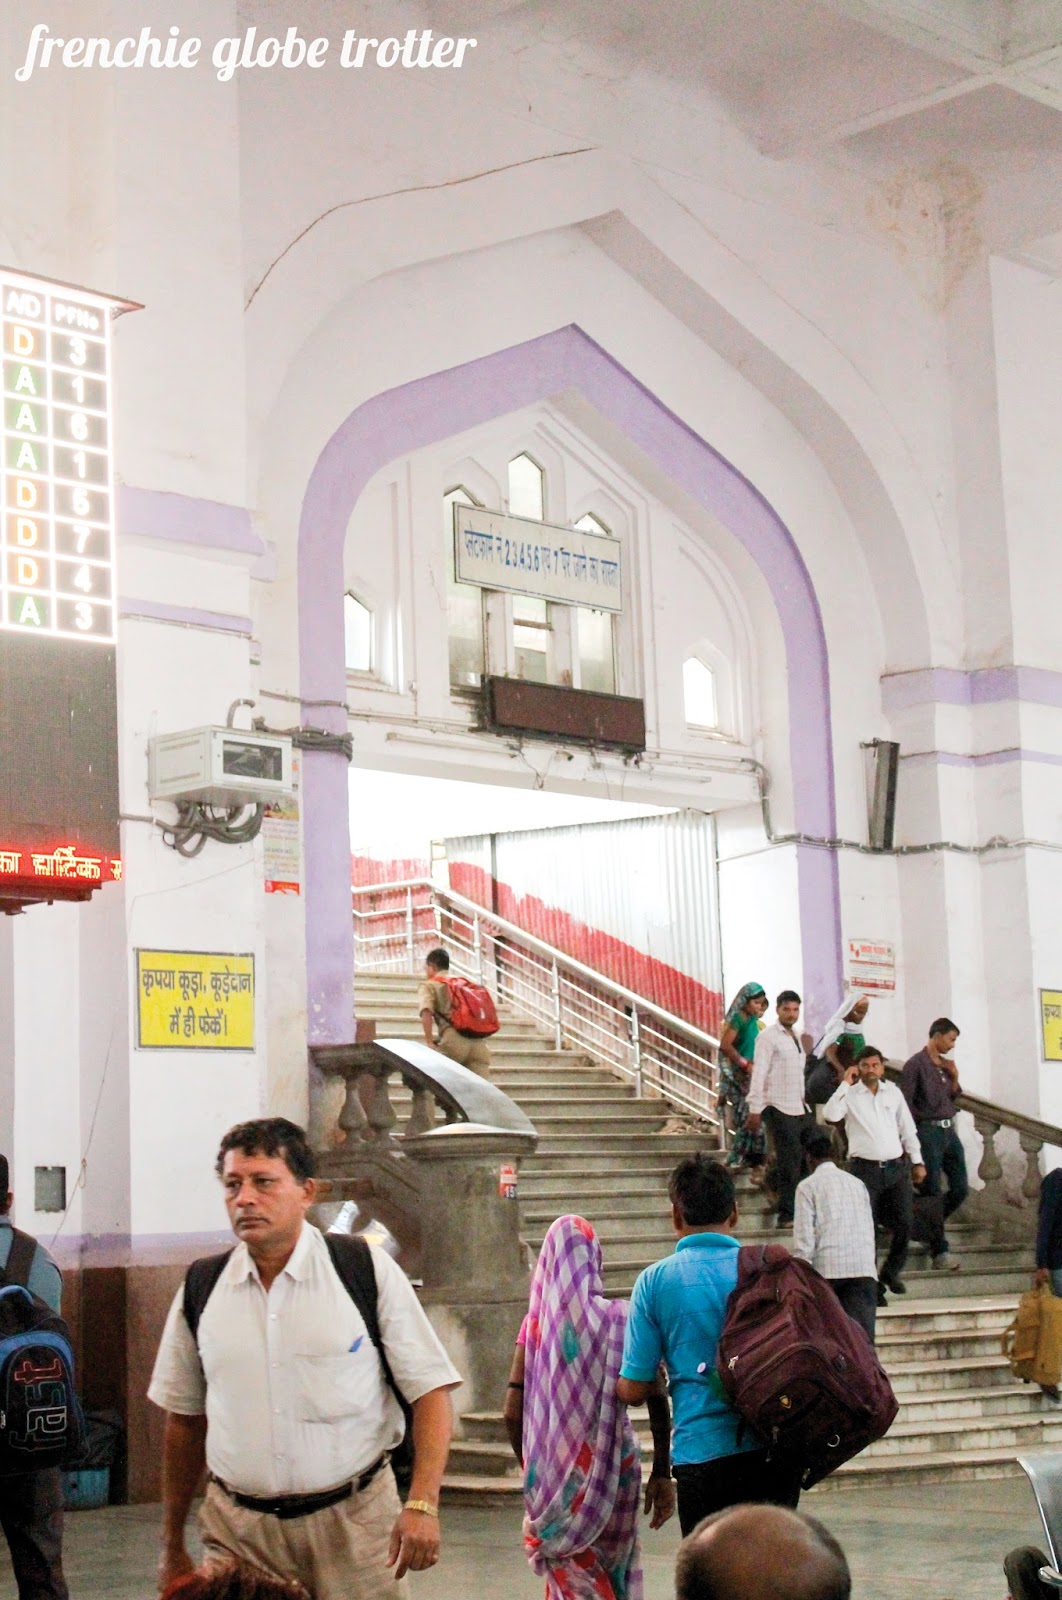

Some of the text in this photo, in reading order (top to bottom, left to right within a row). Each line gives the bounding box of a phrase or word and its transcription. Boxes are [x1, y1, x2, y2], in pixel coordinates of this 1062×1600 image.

[13, 326, 86, 366] D 3
[15, 366, 84, 403] A 1
[16, 403, 88, 440] A 6
[16, 441, 86, 479] A 1
[16, 479, 90, 516] D 6
[17, 517, 91, 553] D 7
[17, 556, 91, 592] D 4
[19, 595, 92, 630] A 3
[142, 968, 175, 997] कृपया
[169, 1006, 181, 1035] में
[183, 1005, 195, 1038] ही
